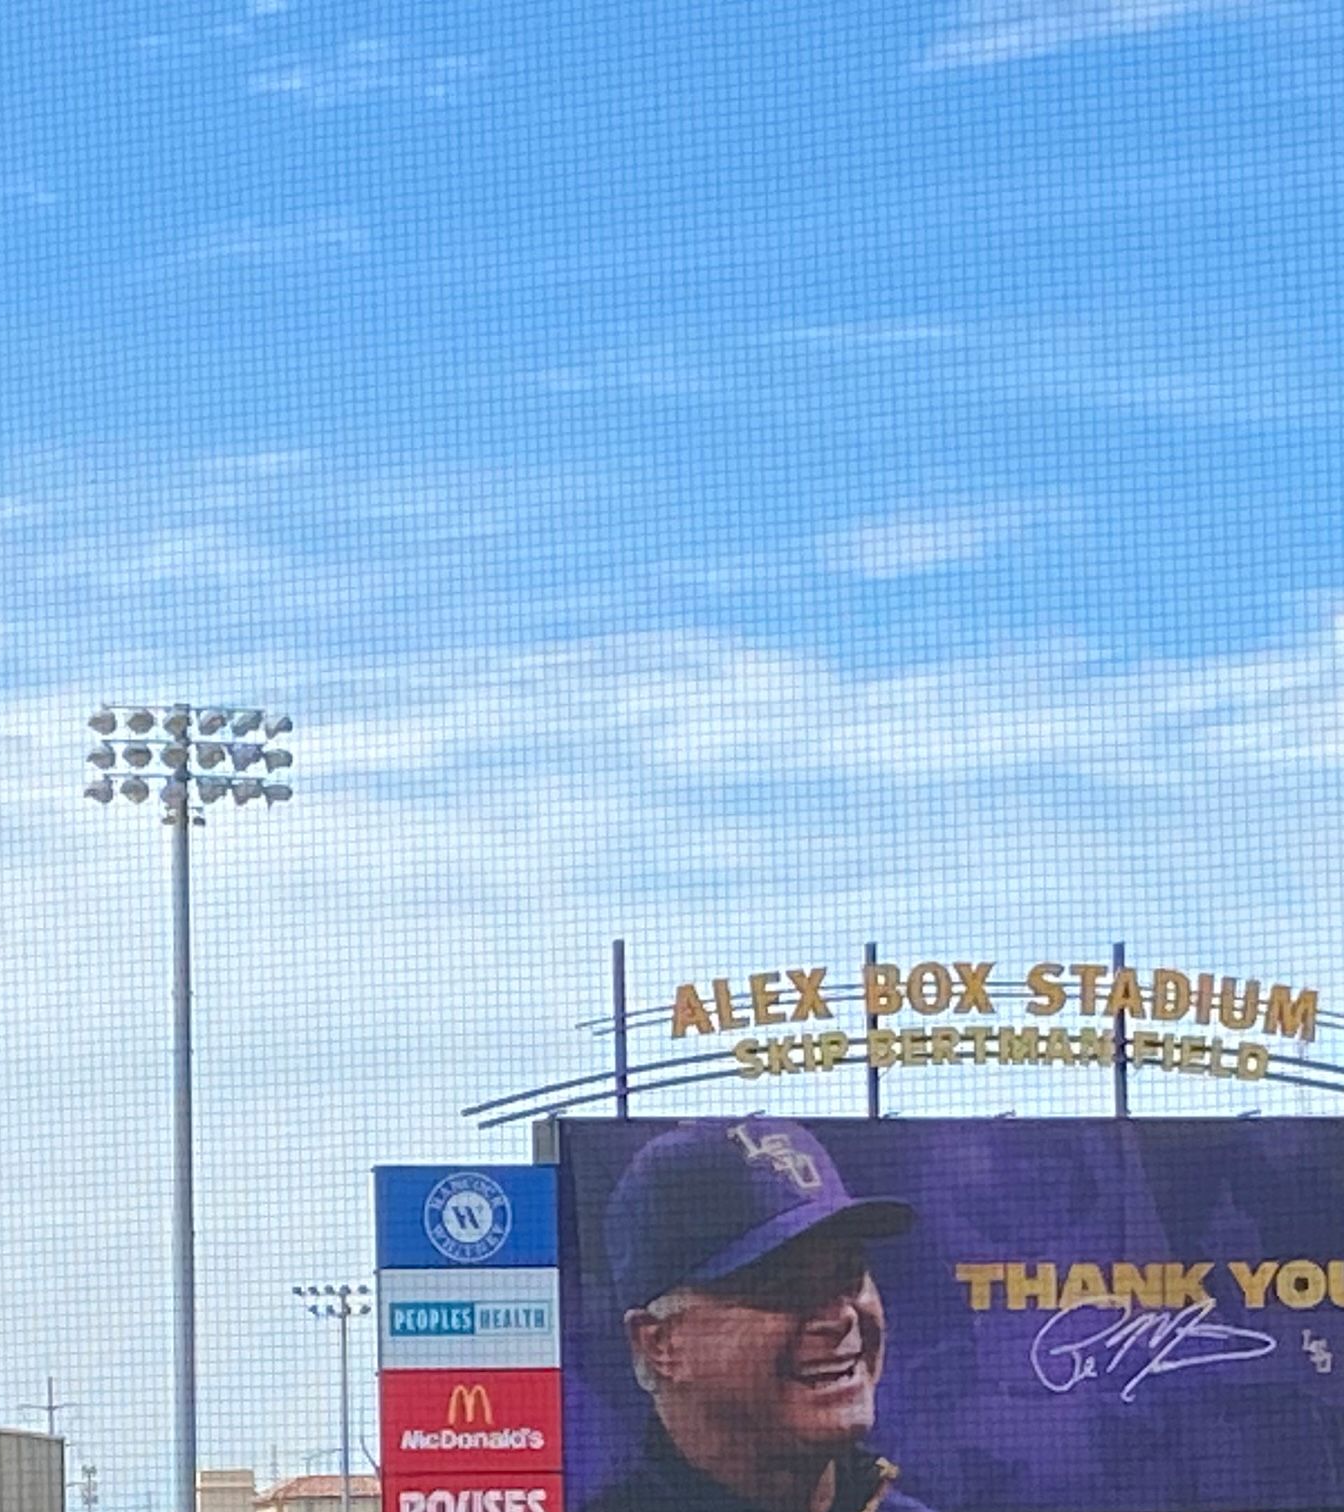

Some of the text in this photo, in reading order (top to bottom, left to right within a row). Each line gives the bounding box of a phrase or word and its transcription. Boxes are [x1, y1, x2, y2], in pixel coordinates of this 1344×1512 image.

[671, 961, 1318, 1042] ALEX BOX STADIUM
[733, 1026, 1269, 1081] SKIP BERTMAN FIELD
[956, 1262, 1216, 1310] THANK
[393, 1308, 546, 1331] PEOPLES HEALTH
[400, 1428, 545, 1450] McDonald's
